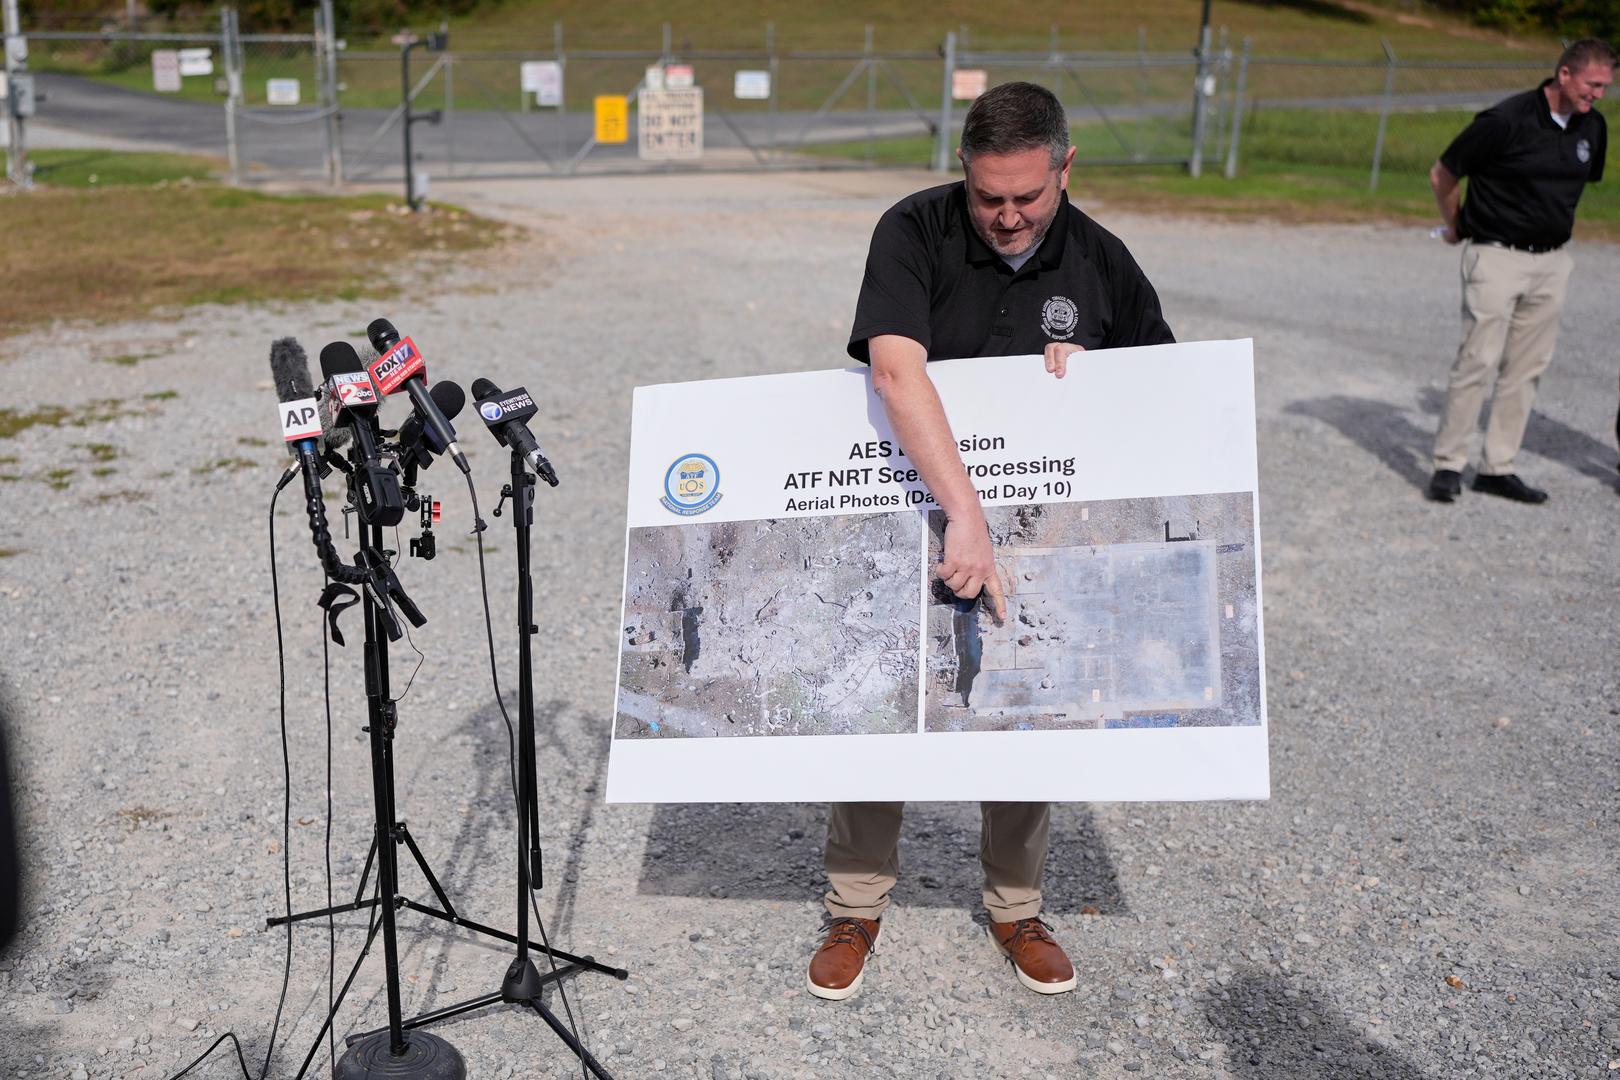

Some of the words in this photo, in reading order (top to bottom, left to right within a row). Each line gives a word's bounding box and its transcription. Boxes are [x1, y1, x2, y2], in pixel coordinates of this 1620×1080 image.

[374, 355, 399, 379] FOX
[395, 343, 410, 361] 17
[335, 371, 369, 384] NEWS
[340, 384, 361, 403] 2
[356, 390, 373, 398] abc
[502, 399, 533, 413] NEWS
[286, 407, 315, 428] AP
[849, 440, 892, 460] AES
[784, 471, 823, 490] ATF
[828, 468, 873, 487] NRT
[878, 466, 922, 484] Sce
[962, 455, 1076, 477] rocessing
[785, 496, 835, 511] Aerial
[839, 493, 900, 508] Photos
[905, 489, 940, 508] (Da
[975, 484, 998, 500] nd
[1003, 483, 1038, 501] Day
[1042, 480, 1072, 498] 10)
